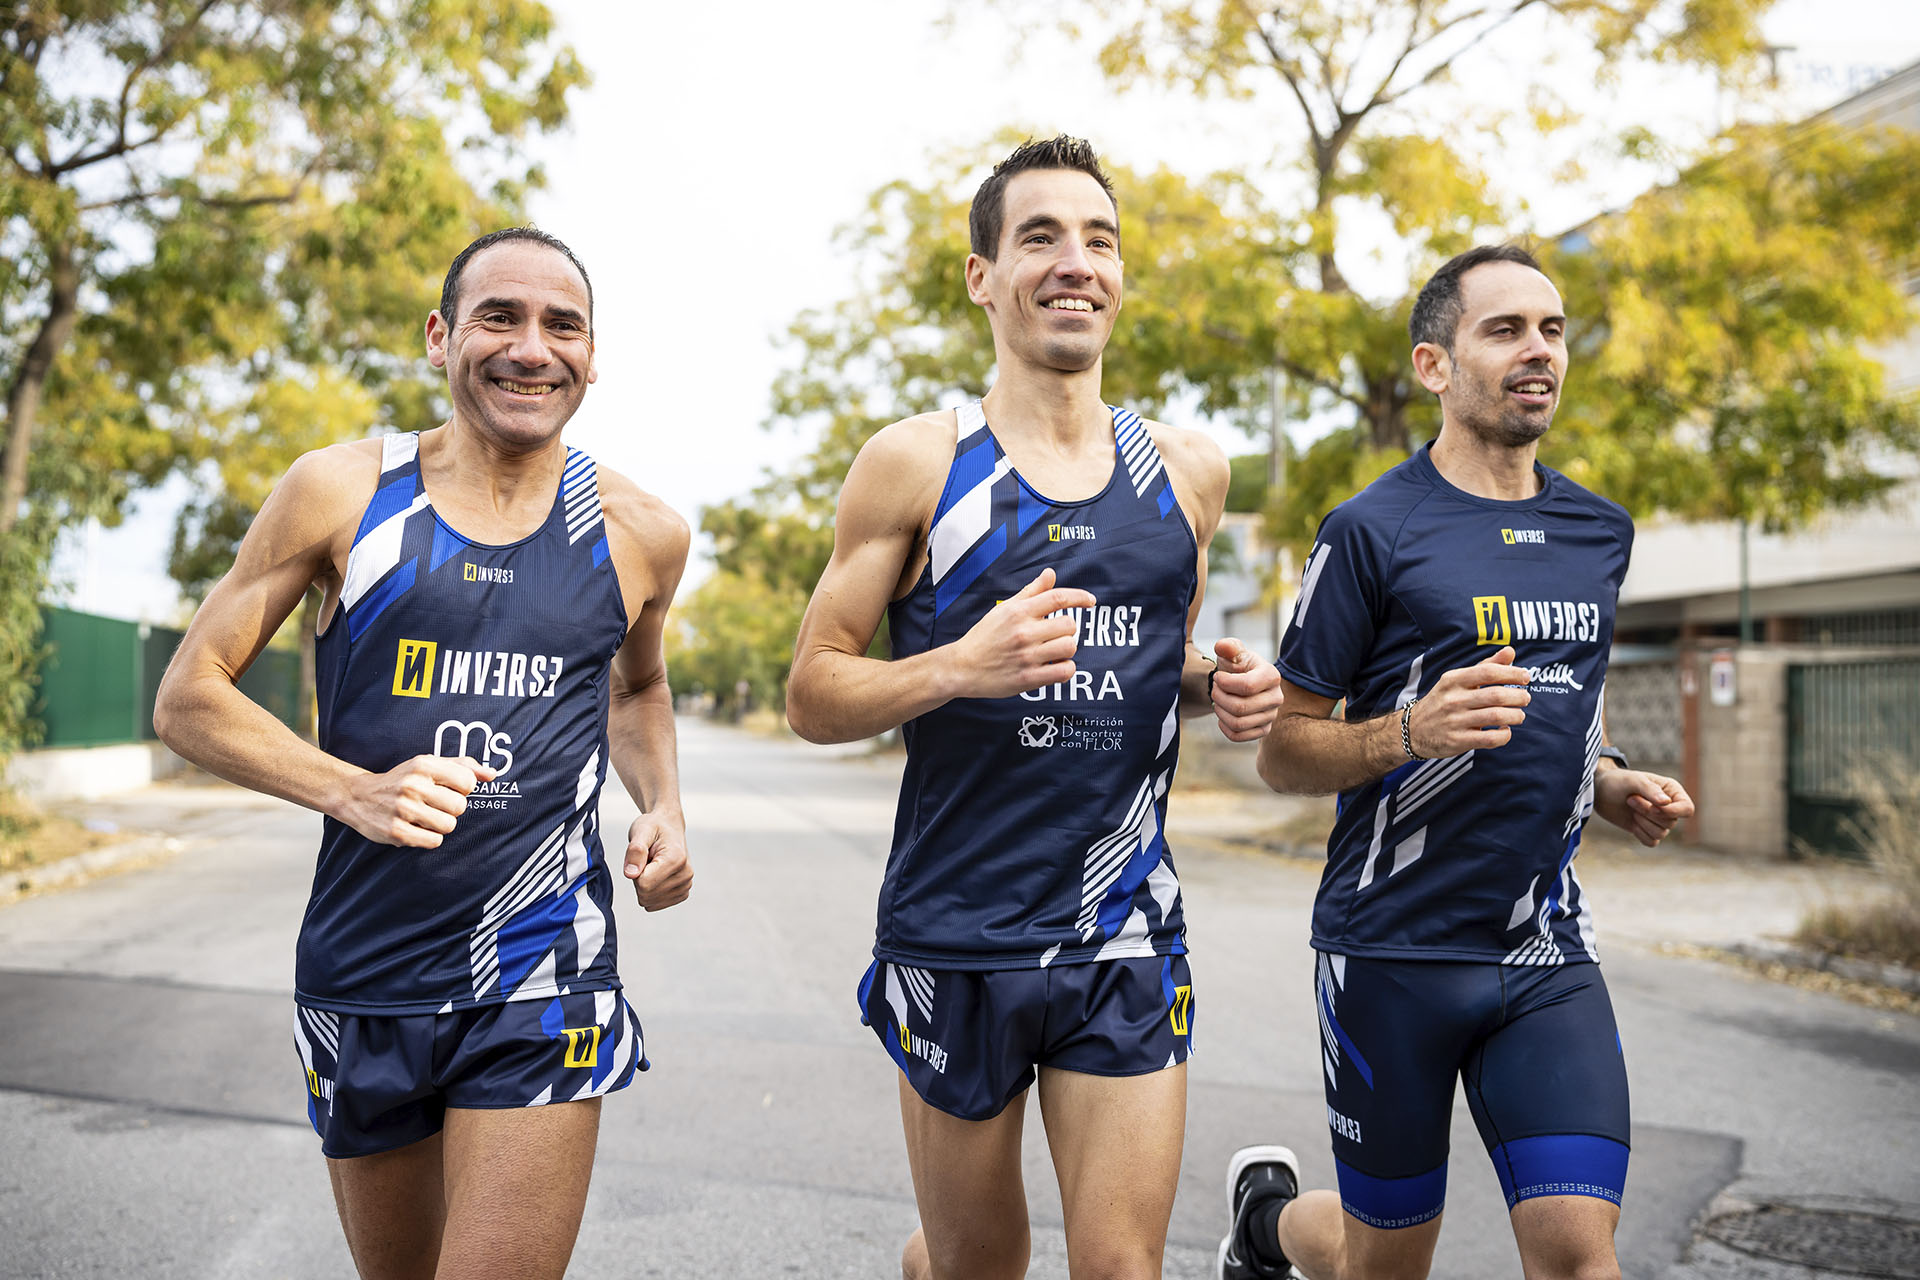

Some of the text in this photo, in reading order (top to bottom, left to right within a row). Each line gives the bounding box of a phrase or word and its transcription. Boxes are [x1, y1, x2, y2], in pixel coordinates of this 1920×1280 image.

[1061, 526, 1095, 540] INVERSE
[478, 566, 514, 583] INVERSE
[1047, 606, 1142, 647] VERSE
[1512, 601, 1600, 642] INVERSE
[440, 650, 563, 697] INVERSE
[1530, 686, 1569, 694] NUTRITION
[1062, 715, 1124, 727] Nutrición
[1062, 725, 1123, 742] Deportiva
[1085, 738, 1122, 750] FLOR
[467, 800, 508, 810] ASSAGE
